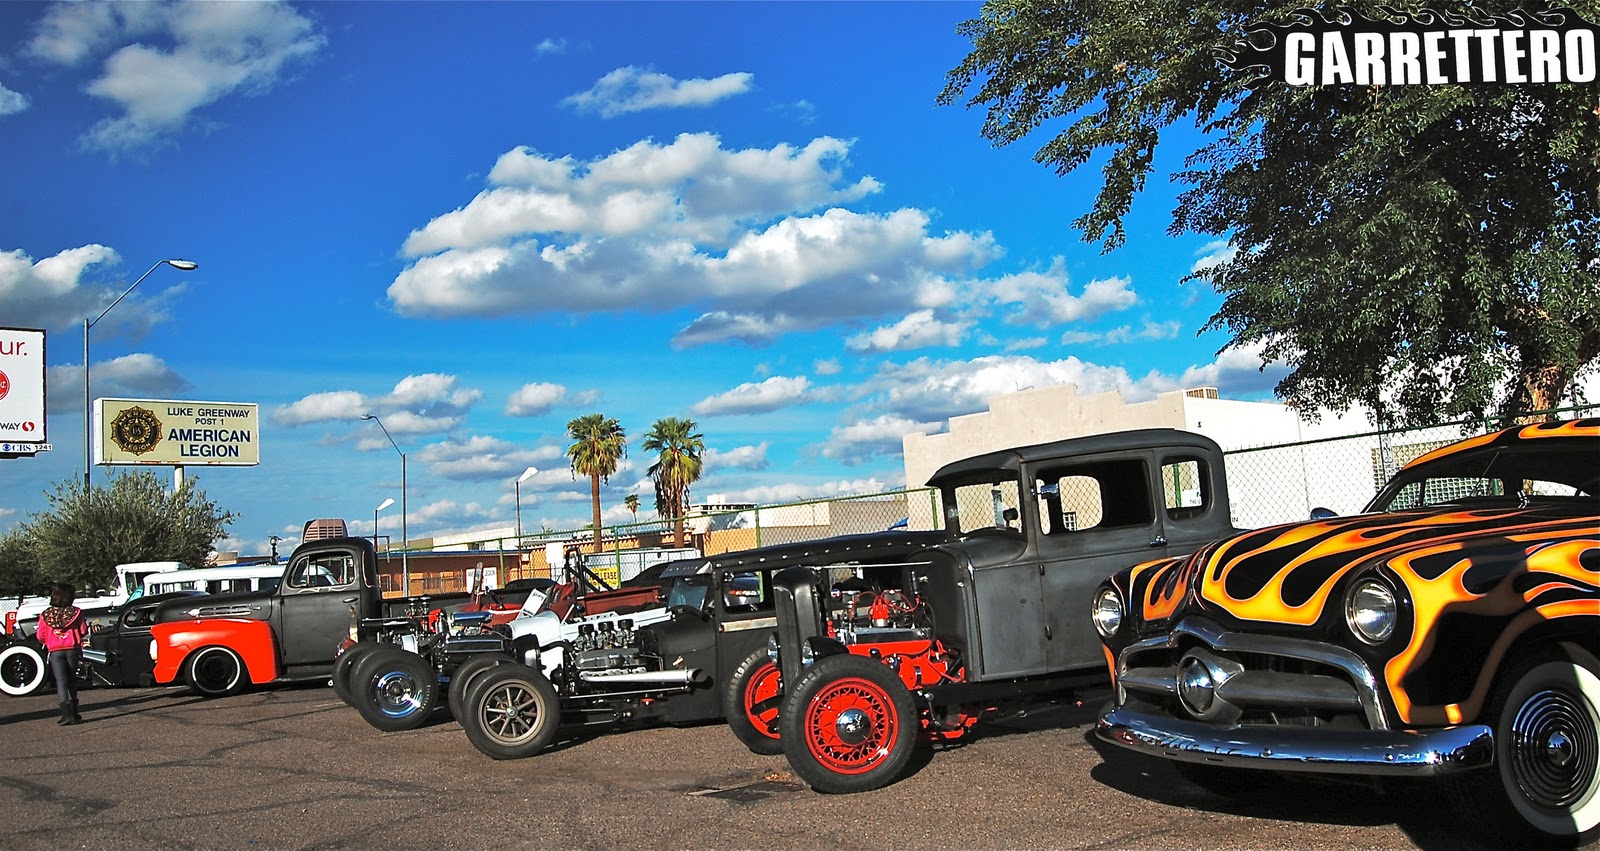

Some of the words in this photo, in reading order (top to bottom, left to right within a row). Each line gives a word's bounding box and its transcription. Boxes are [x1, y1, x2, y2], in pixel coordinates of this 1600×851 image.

[167, 407, 193, 417] LUKE
[197, 408, 250, 418] GREENWAY
[167, 429, 251, 442] AMERICAN
[12, 444, 32, 452] CBS
[180, 444, 239, 457] LEGION
